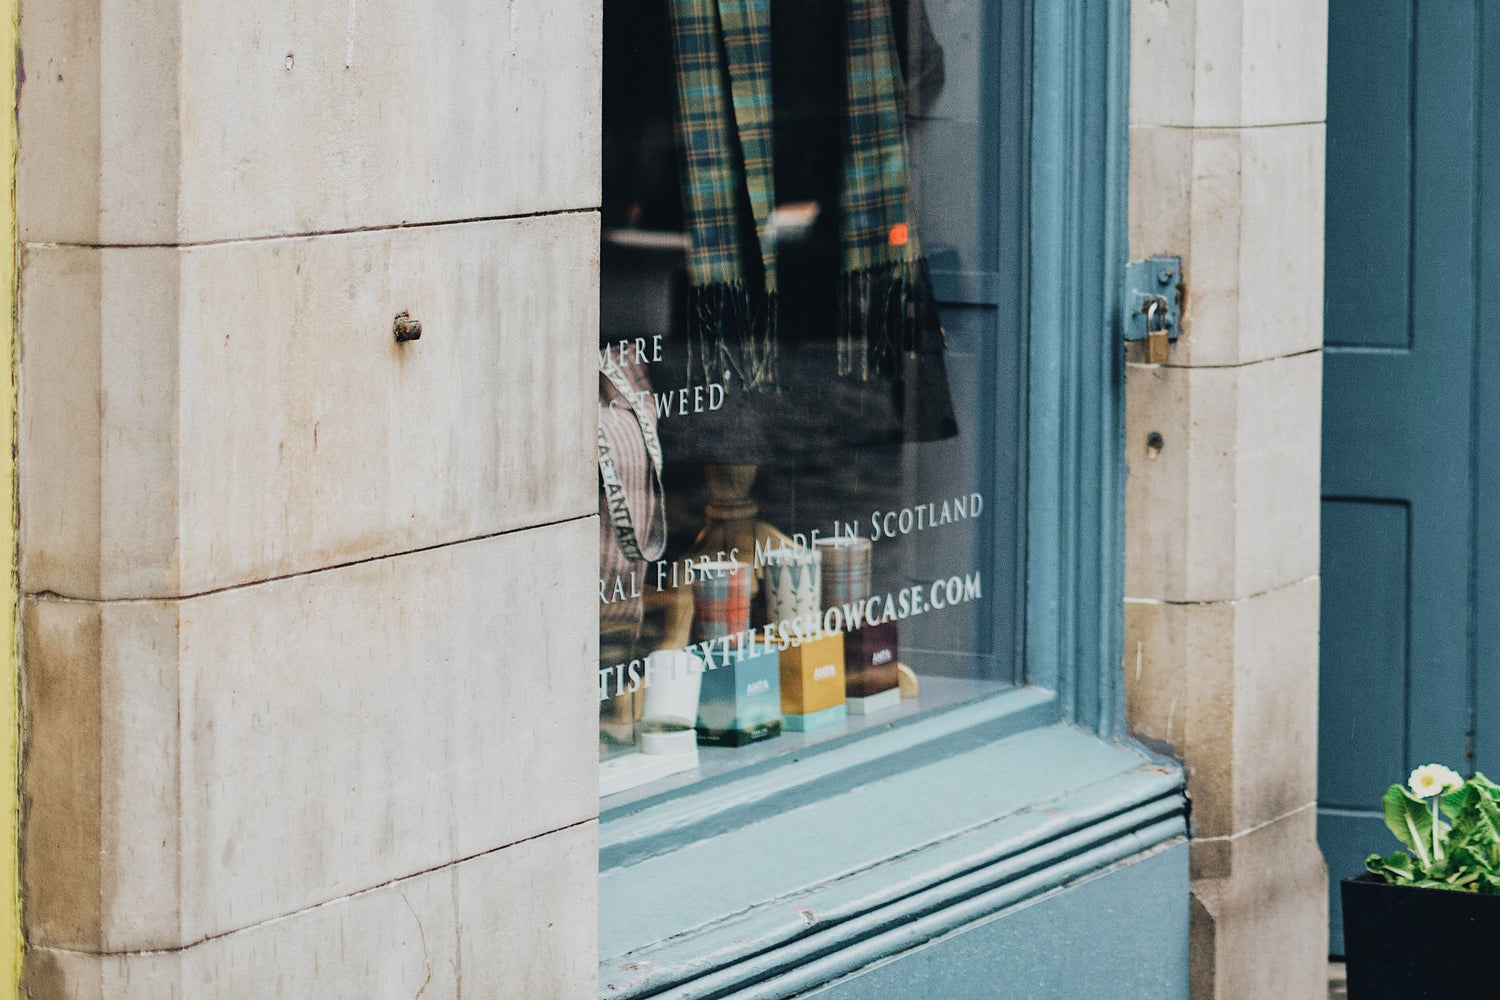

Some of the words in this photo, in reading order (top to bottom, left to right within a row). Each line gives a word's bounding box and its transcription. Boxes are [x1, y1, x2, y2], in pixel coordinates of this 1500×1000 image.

[656, 547, 739, 592] FIBRES
[753, 529, 821, 569] MADE
[834, 520, 859, 548] IN
[870, 492, 983, 541] SCOTLAND
